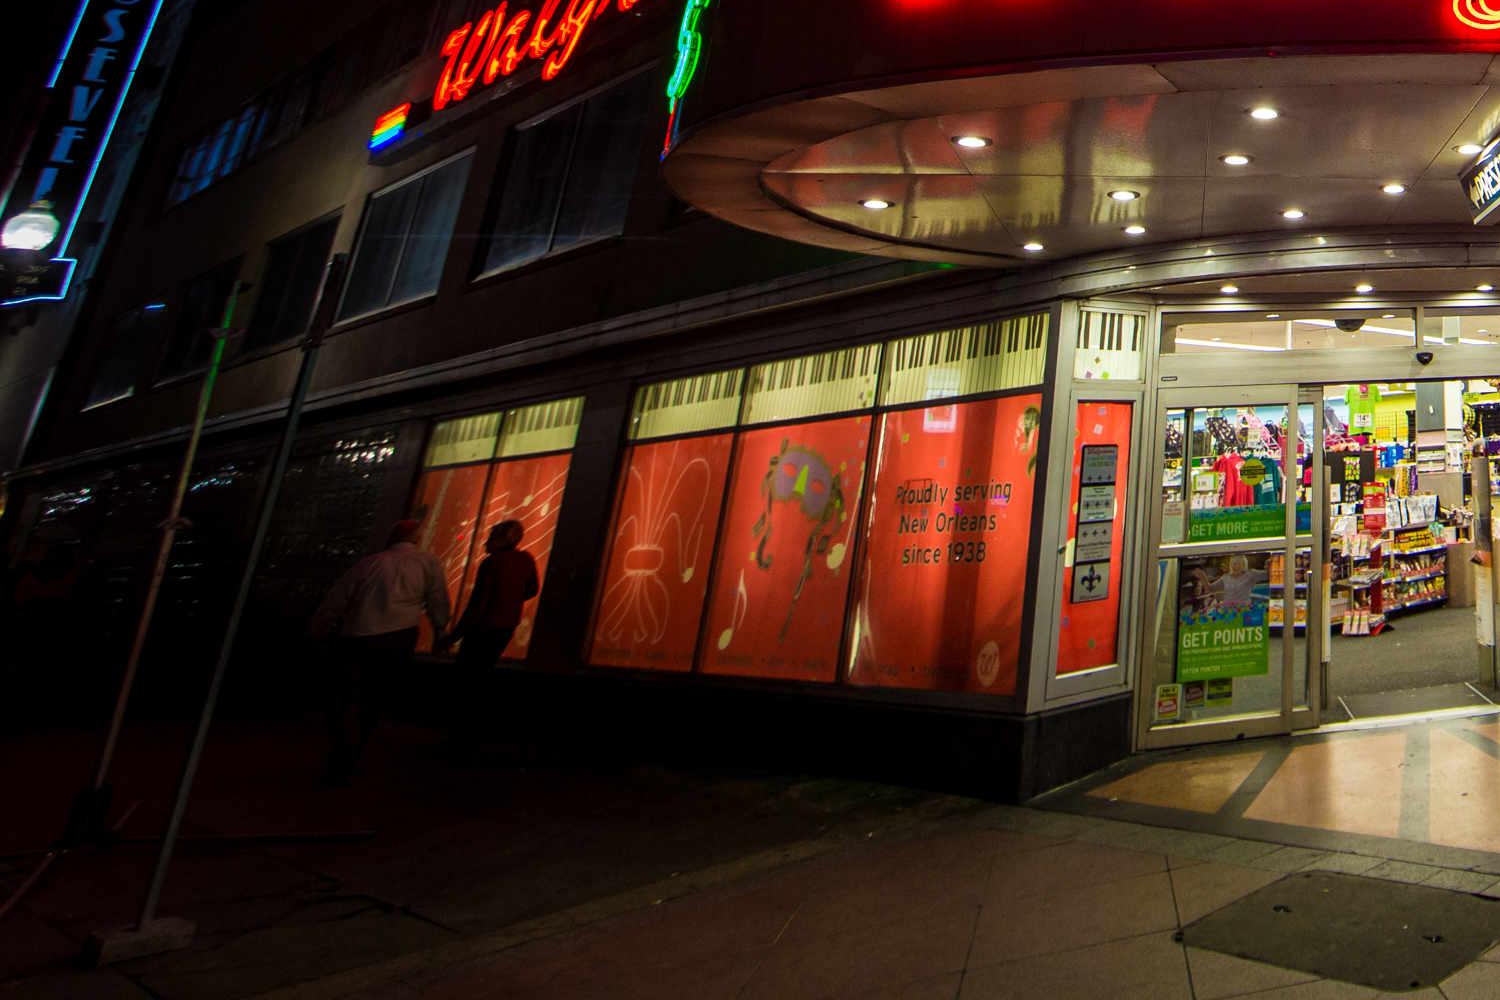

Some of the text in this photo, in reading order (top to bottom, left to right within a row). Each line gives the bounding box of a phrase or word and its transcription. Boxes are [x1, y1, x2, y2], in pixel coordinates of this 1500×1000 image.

[895, 479, 1012, 507] Proudly serving
[899, 511, 997, 535] New Orleans
[1191, 524, 1214, 537] GET
[1216, 521, 1249, 535] MORE
[902, 541, 987, 565] since 1938
[1182, 626, 1264, 648] GET POINTS
